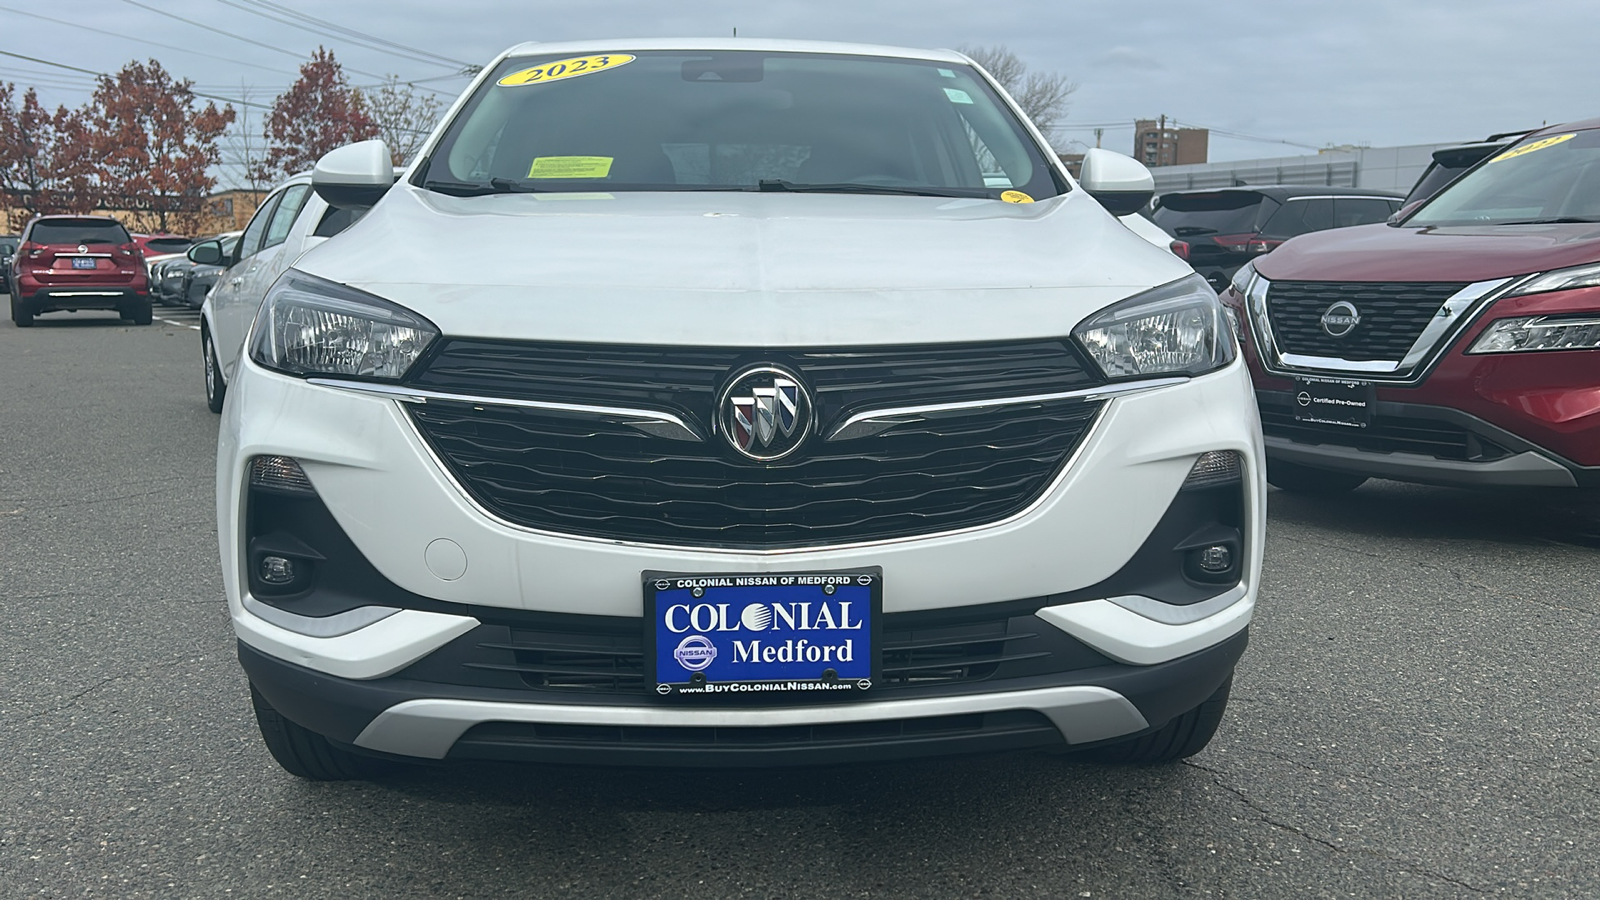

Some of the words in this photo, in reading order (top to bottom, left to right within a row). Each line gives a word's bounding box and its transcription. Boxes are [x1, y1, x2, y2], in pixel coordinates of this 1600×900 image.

[524, 56, 610, 83] 2023
[1321, 315, 1361, 325] NISSAN
[1313, 397, 1335, 405] Certified
[1336, 399, 1366, 407] Pre-Owned
[677, 579, 733, 588] COLONIAL
[736, 577, 777, 586] NISSAN
[780, 577, 795, 585] OF
[797, 576, 851, 585] MEDFORD
[664, 601, 863, 633] COLONIAL
[679, 649, 713, 657] NISSAN
[732, 638, 854, 664] Medford
